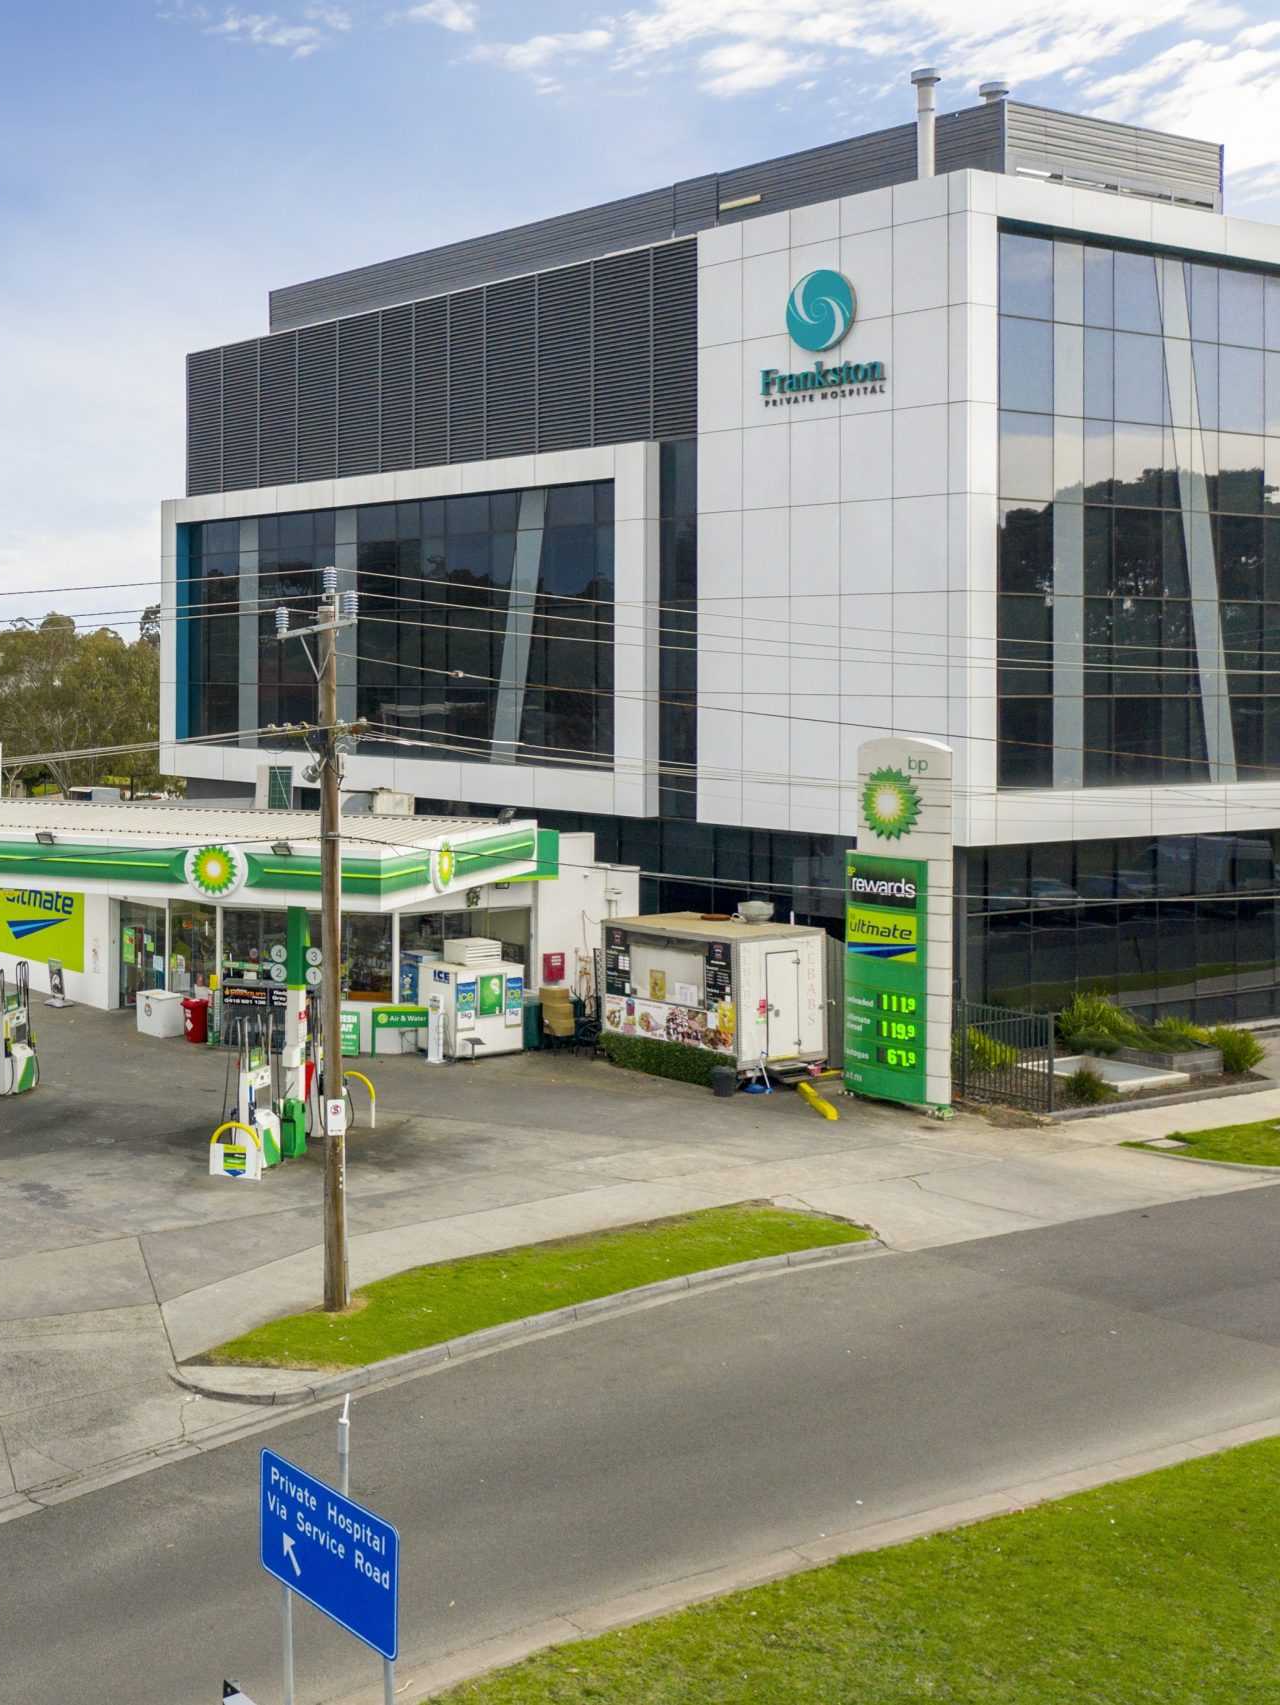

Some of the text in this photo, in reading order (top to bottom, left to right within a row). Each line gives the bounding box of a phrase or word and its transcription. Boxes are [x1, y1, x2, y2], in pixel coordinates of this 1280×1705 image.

[760, 360, 886, 396] Frankston
[764, 384, 886, 408] PRIVATE HOSPITAL
[907, 755, 929, 775] bp
[851, 877, 917, 899] rewards
[849, 919, 913, 941] ultimate
[433, 969, 450, 981] ICE
[388, 1014, 400, 1022] Air
[407, 1014, 427, 1022] Water
[270, 1466, 387, 1556] Private Hospital
[267, 1491, 391, 1591] Via Service Road
